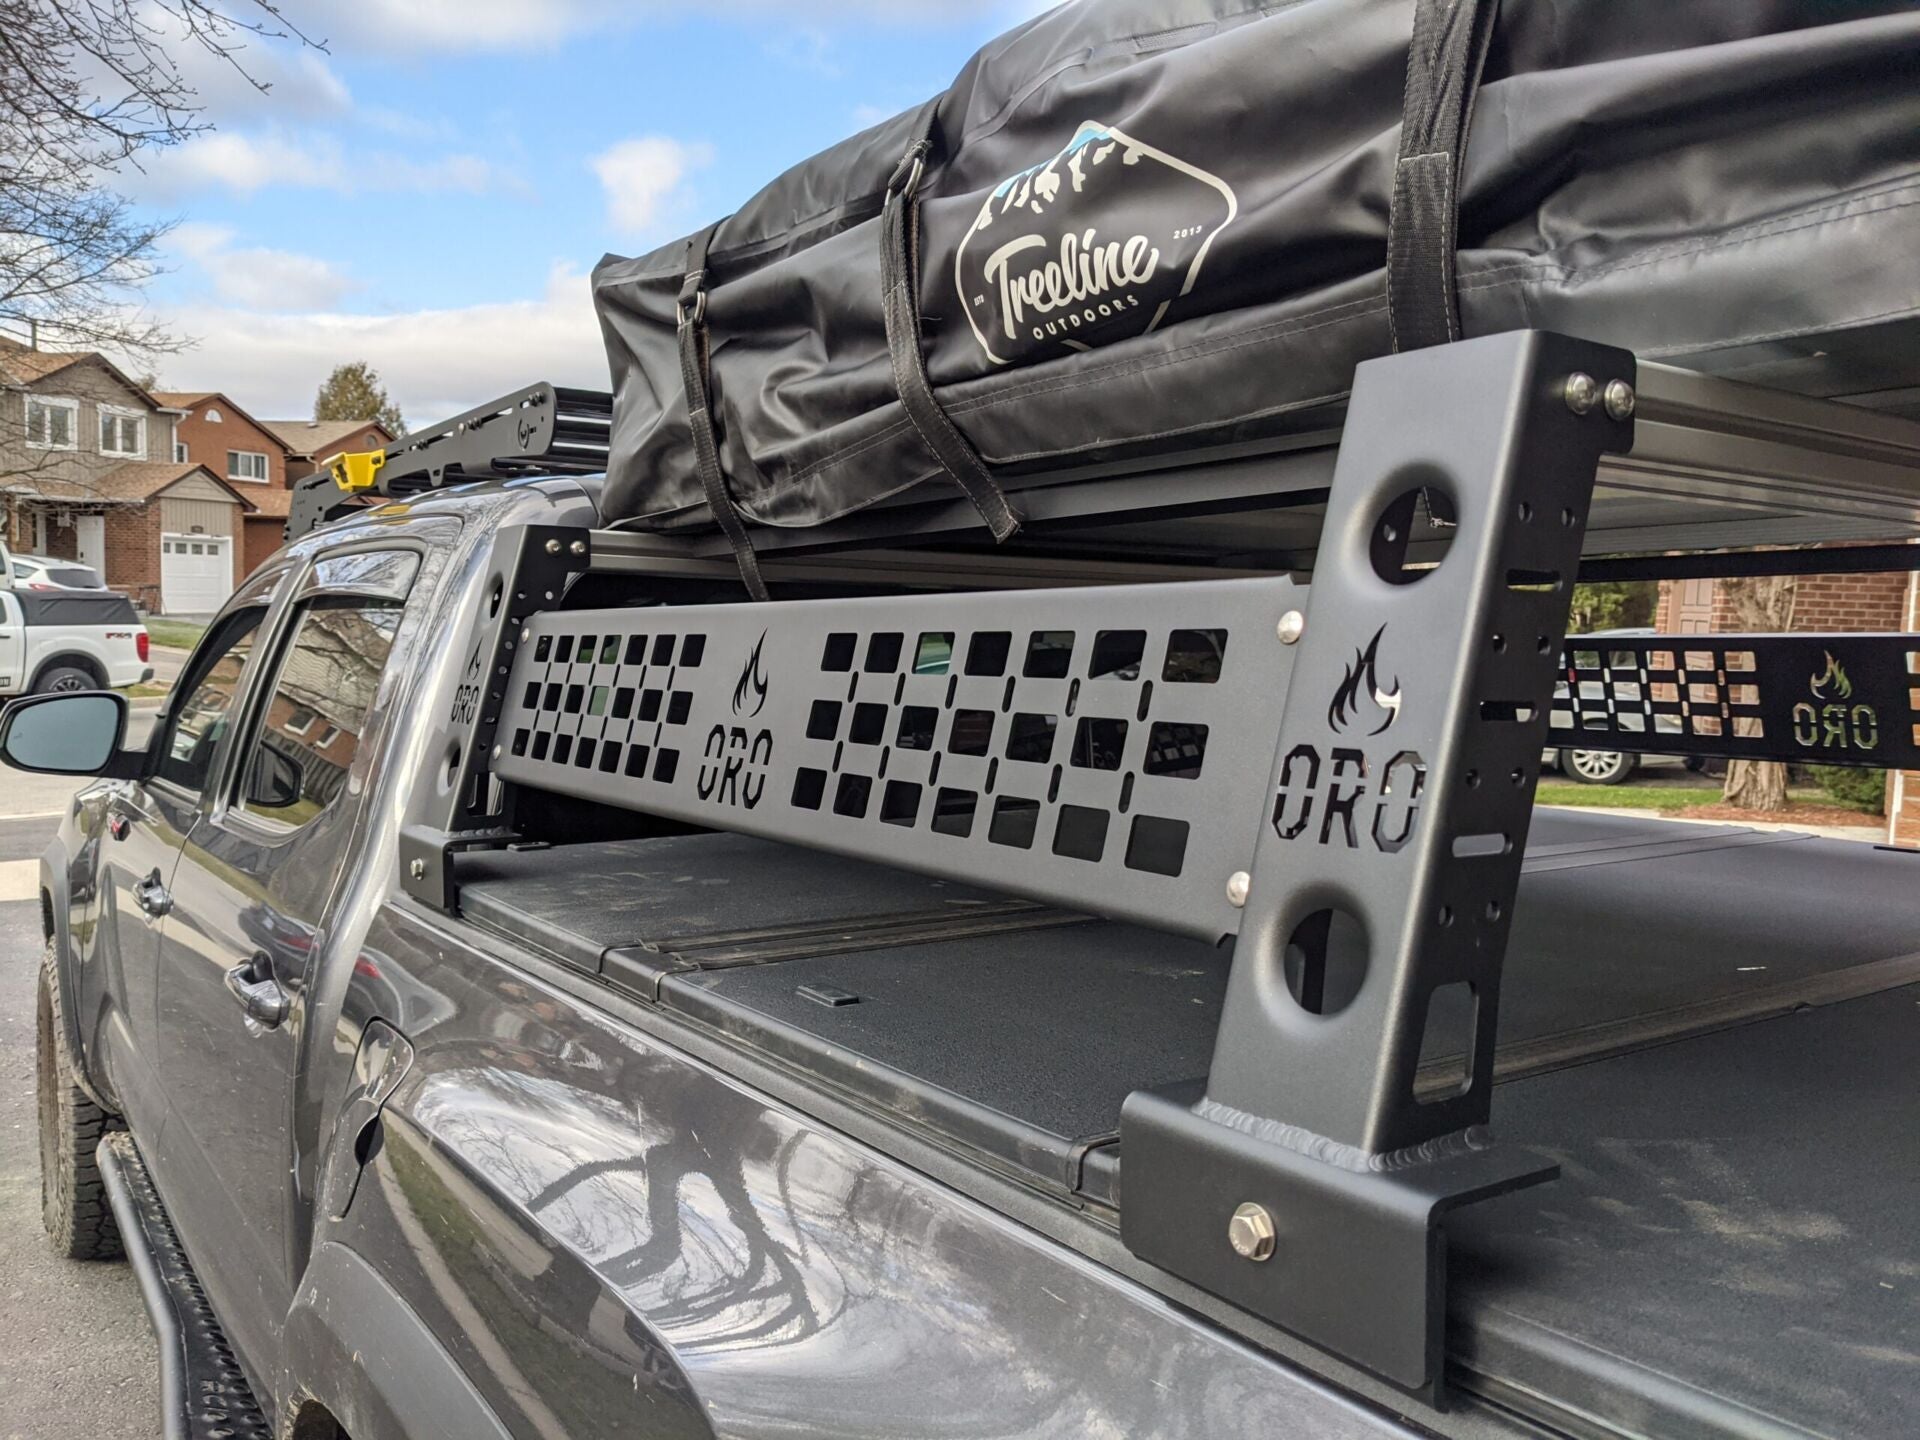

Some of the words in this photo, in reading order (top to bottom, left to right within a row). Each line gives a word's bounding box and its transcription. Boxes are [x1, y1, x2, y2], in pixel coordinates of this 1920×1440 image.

[984, 228, 1160, 340] Treeline
[1033, 295, 1139, 340] OUTDOORS
[451, 684, 479, 725] ORO
[697, 724, 773, 810] ORO
[1272, 744, 1427, 854] ORO
